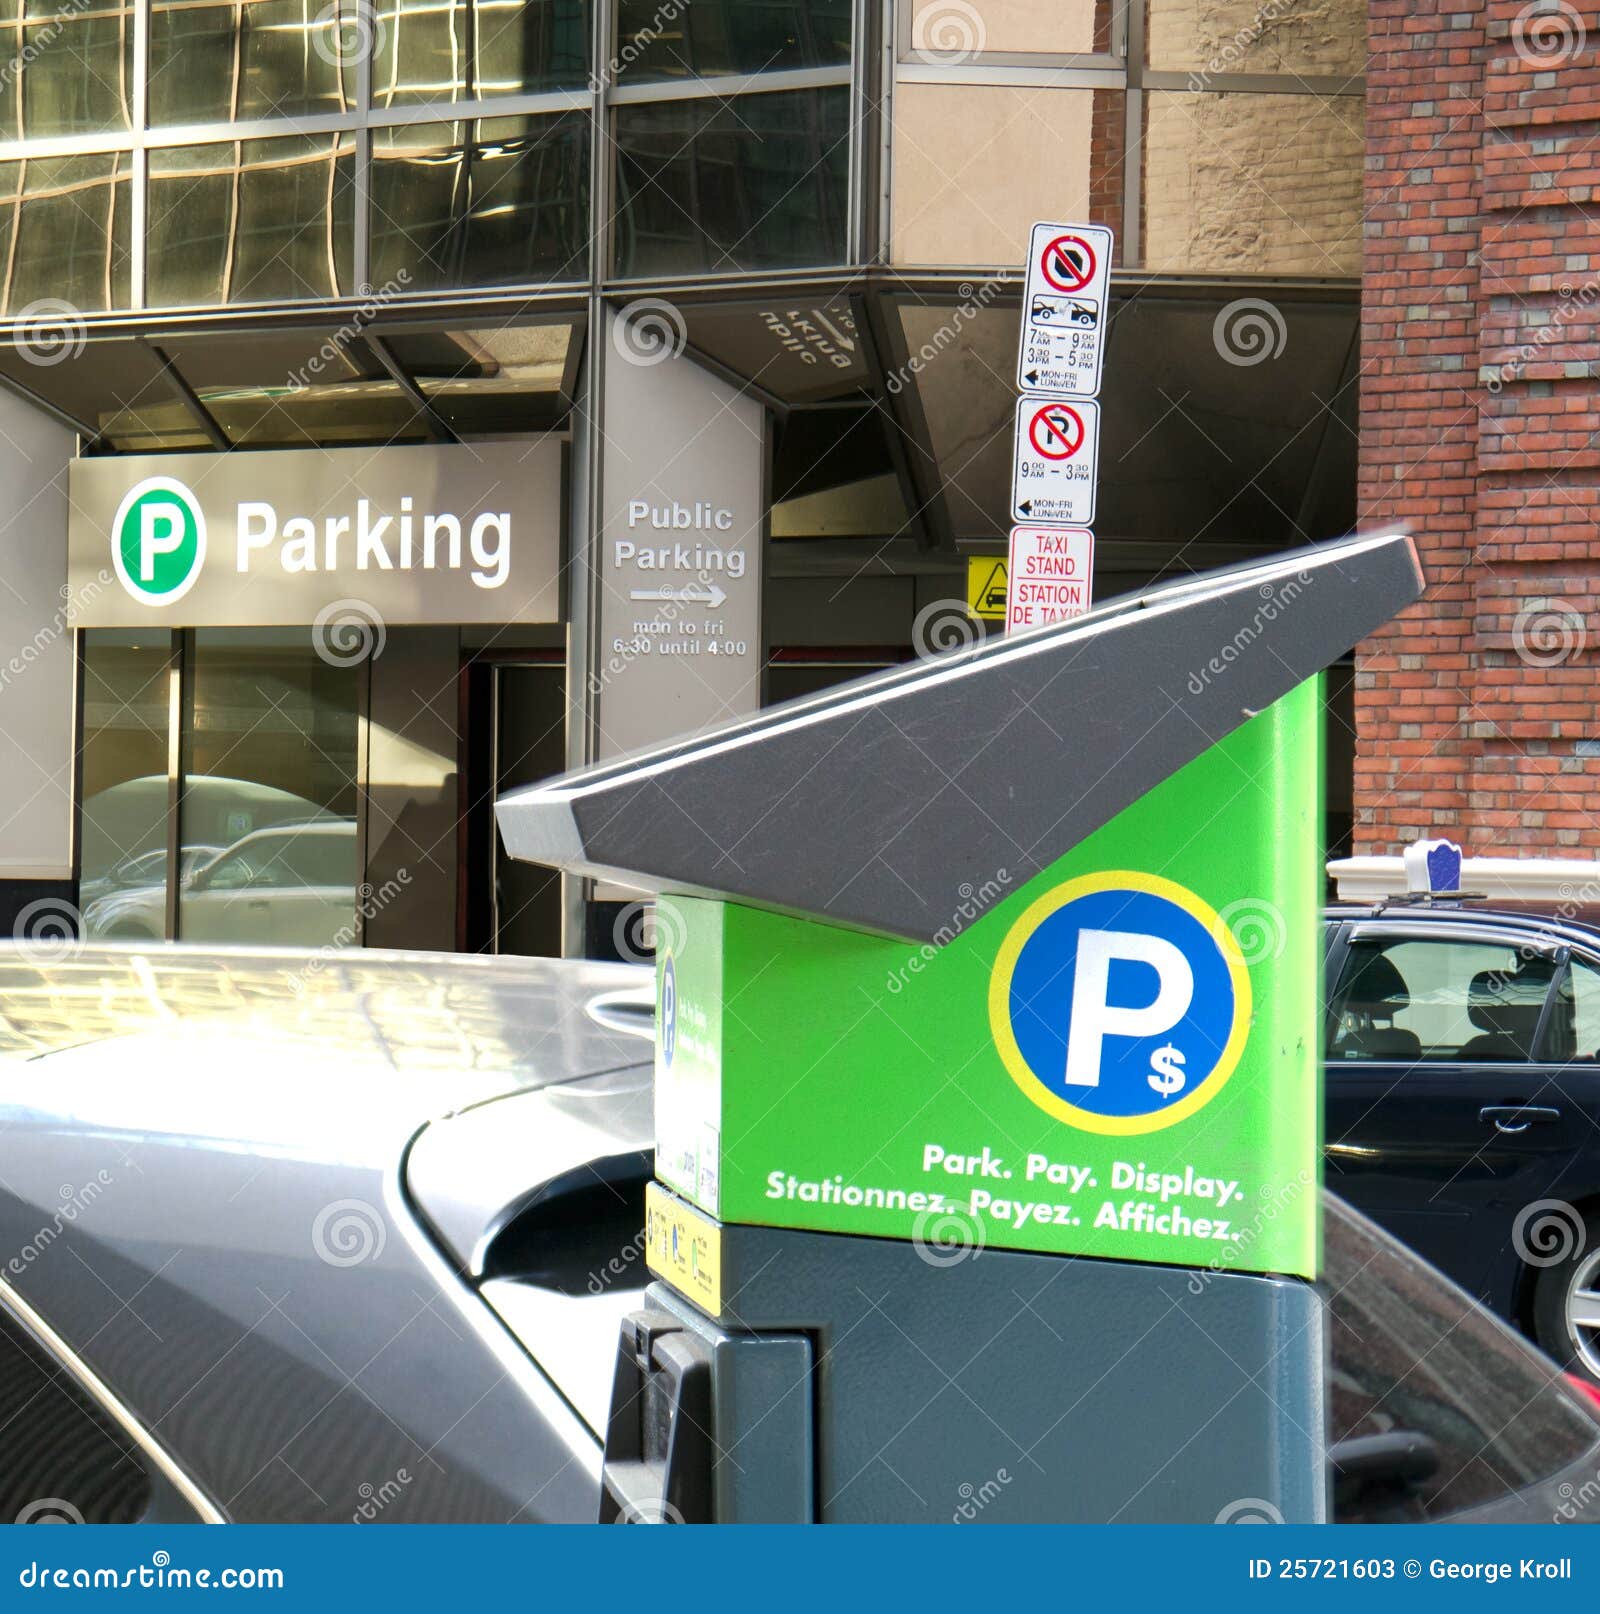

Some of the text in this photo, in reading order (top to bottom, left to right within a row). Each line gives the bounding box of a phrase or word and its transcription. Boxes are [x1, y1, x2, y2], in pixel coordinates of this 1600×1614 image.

[1030, 328, 1037, 344] 7
[1072, 332, 1080, 349] 9
[1081, 342, 1095, 350] AM
[1027, 347, 1035, 363] 3
[1068, 350, 1076, 366] 5
[1040, 379, 1077, 388] LUNVEN
[1041, 370, 1078, 380] MON-FRI
[1021, 461, 1029, 478] 9
[1066, 464, 1073, 480] 3
[1033, 499, 1073, 509] MON-FRI
[628, 500, 733, 530] Public
[236, 496, 511, 589] Parking
[1036, 535, 1068, 554] TAXI
[615, 541, 746, 578] Parking
[1026, 555, 1075, 576] STAND
[1018, 583, 1081, 605] STATION
[1013, 606, 1033, 624] DE
[633, 619, 724, 635] mon to fri
[613, 638, 746, 655] 6:30 until 4:00
[923, 1143, 1244, 1209] Park. Pay. Display.
[765, 1171, 955, 1214] Stationnez.
[969, 1188, 1081, 1229] Payez.
[1093, 1200, 1240, 1241] Affichez.
